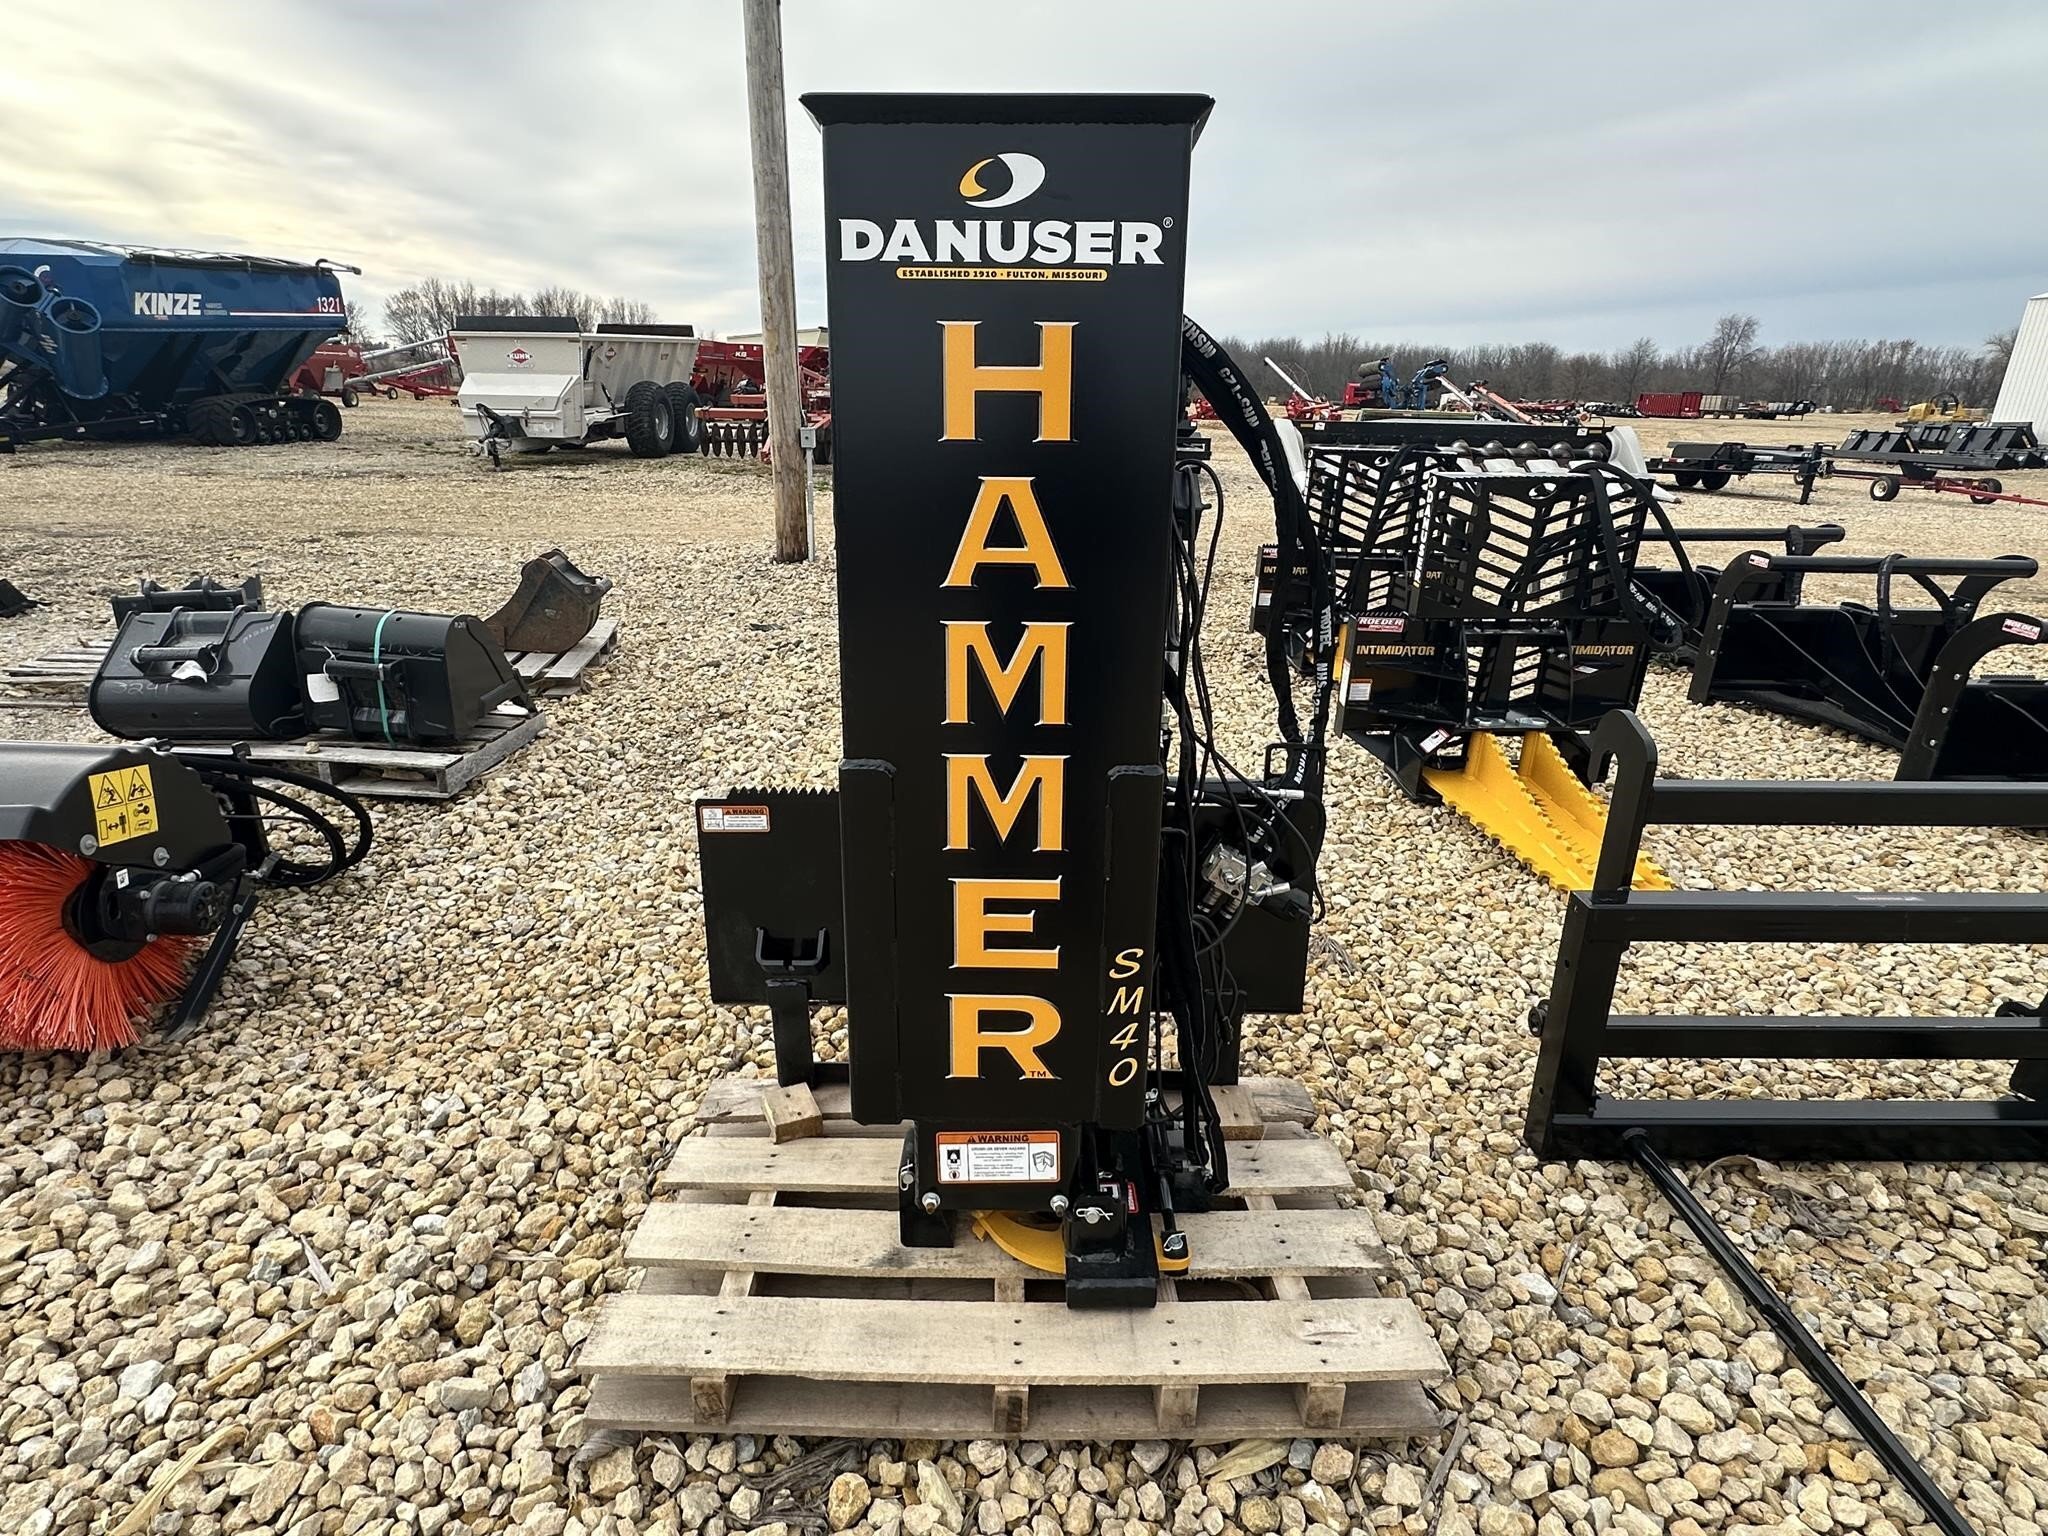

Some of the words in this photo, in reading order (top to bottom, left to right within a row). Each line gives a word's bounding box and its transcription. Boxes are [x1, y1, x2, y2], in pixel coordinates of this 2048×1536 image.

[902, 270, 970, 279] ESTABLISHED
[973, 270, 997, 279] 1910
[1006, 270, 1049, 280] FULTON,
[1051, 271, 1103, 280] MISSOURI
[134, 292, 202, 316] KINZE
[316, 297, 340, 313] 1321
[1183, 317, 1217, 359] MSHA
[1356, 645, 1436, 657] INTIMIDATOR
[936, 320, 1080, 1080] HAMMER
[1106, 948, 1145, 1087] SM40
[977, 1134, 1030, 1143] WARNING
